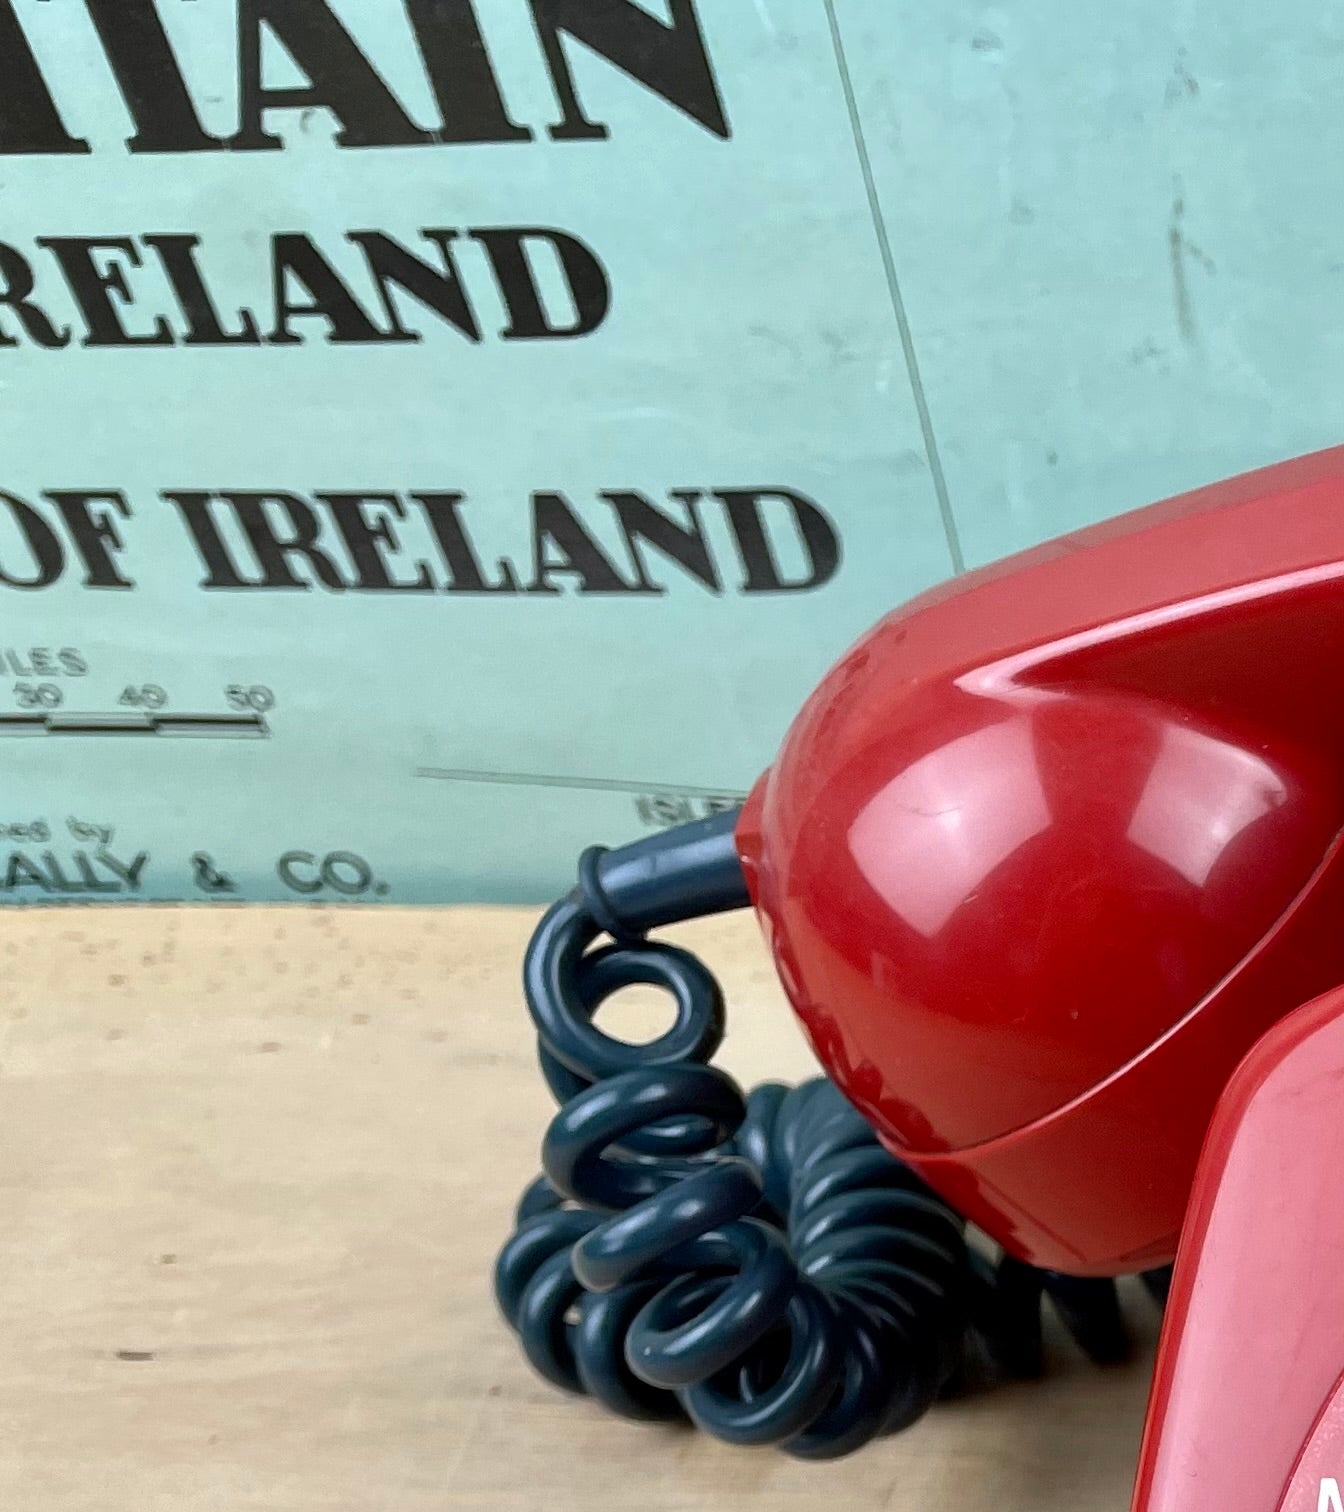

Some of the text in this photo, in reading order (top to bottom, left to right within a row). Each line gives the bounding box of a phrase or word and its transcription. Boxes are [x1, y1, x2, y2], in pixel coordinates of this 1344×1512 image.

[159, 485, 843, 597] IRELAND
[12, 681, 275, 712] 30 40 50
[191, 850, 238, 893] &
[276, 850, 390, 896] CO.
